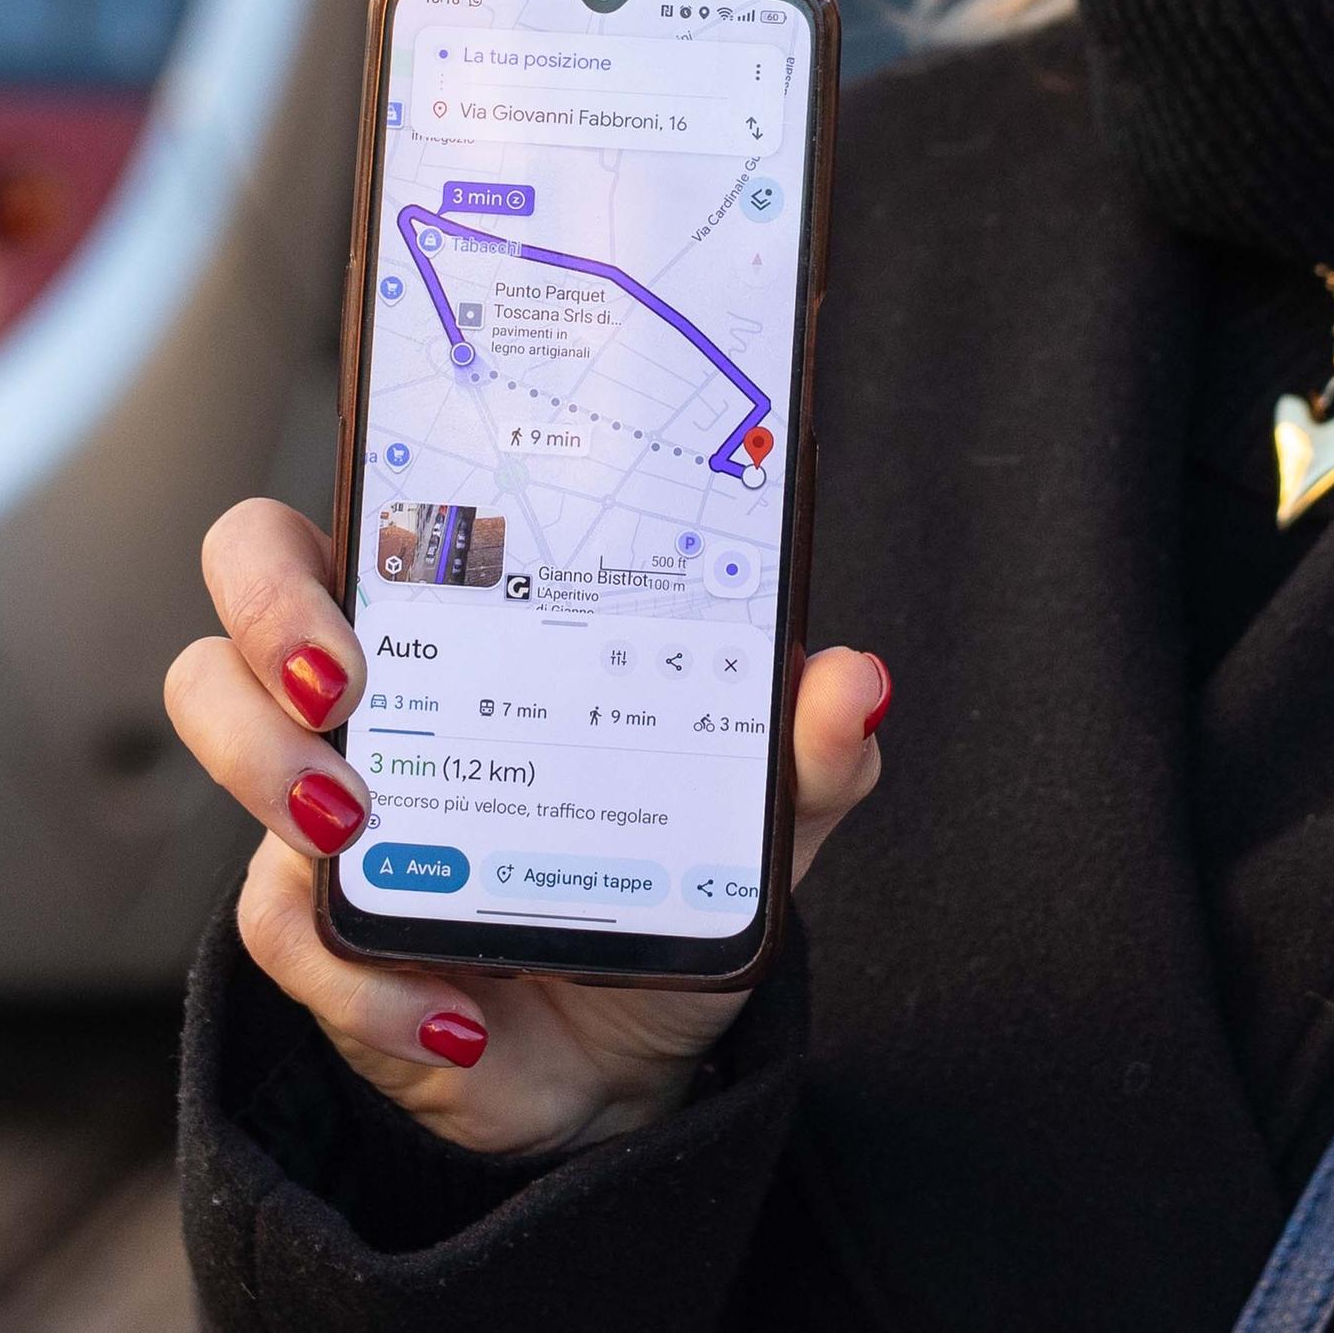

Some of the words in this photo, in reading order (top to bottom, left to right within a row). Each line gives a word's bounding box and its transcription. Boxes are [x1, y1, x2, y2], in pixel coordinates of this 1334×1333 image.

[464, 47, 483, 63] La
[490, 49, 519, 65] tua
[524, 50, 612, 70] posizione
[460, 102, 487, 120] Via
[493, 104, 575, 125] Giovanni
[579, 108, 663, 132] Fabbroni,
[669, 114, 687, 131] 16
[452, 187, 463, 203] 3
[468, 189, 502, 205] min
[691, 221, 711, 242] Via
[707, 170, 750, 226] Cardinale
[495, 282, 541, 298] Punto
[546, 284, 605, 305] Parquet
[494, 304, 559, 321] Toscana
[564, 307, 592, 322] Srls
[492, 324, 552, 341] pavimenti
[555, 327, 567, 339] in
[491, 341, 526, 358] legno
[530, 343, 590, 360] artigianali
[531, 430, 541, 444] 9
[546, 431, 580, 447] min
[651, 555, 674, 569] 500
[676, 555, 687, 568] ft
[538, 566, 592, 584] Gianno
[648, 577, 669, 591] 100
[673, 580, 686, 591] m
[537, 586, 599, 601] L'Aperitivo
[377, 636, 438, 659] Auto
[394, 695, 403, 708] 3
[408, 696, 439, 711] min
[502, 702, 511, 716] 7
[516, 703, 547, 718] min
[611, 709, 620, 723] 9
[625, 710, 656, 726] min
[720, 716, 729, 731] 3
[734, 717, 765, 733] min
[370, 753, 383, 772] 3
[390, 754, 436, 775] min
[443, 755, 482, 782] (1,2
[489, 759, 536, 786] km)
[369, 790, 439, 809] Percorso
[444, 793, 469, 813] più
[474, 796, 530, 817] veloce,
[536, 799, 595, 820] traffico
[600, 806, 668, 825] regolare
[406, 859, 451, 876] Avvia
[524, 867, 598, 888] Aggiungi
[603, 872, 652, 892] tappe
[725, 880, 759, 897] Con
